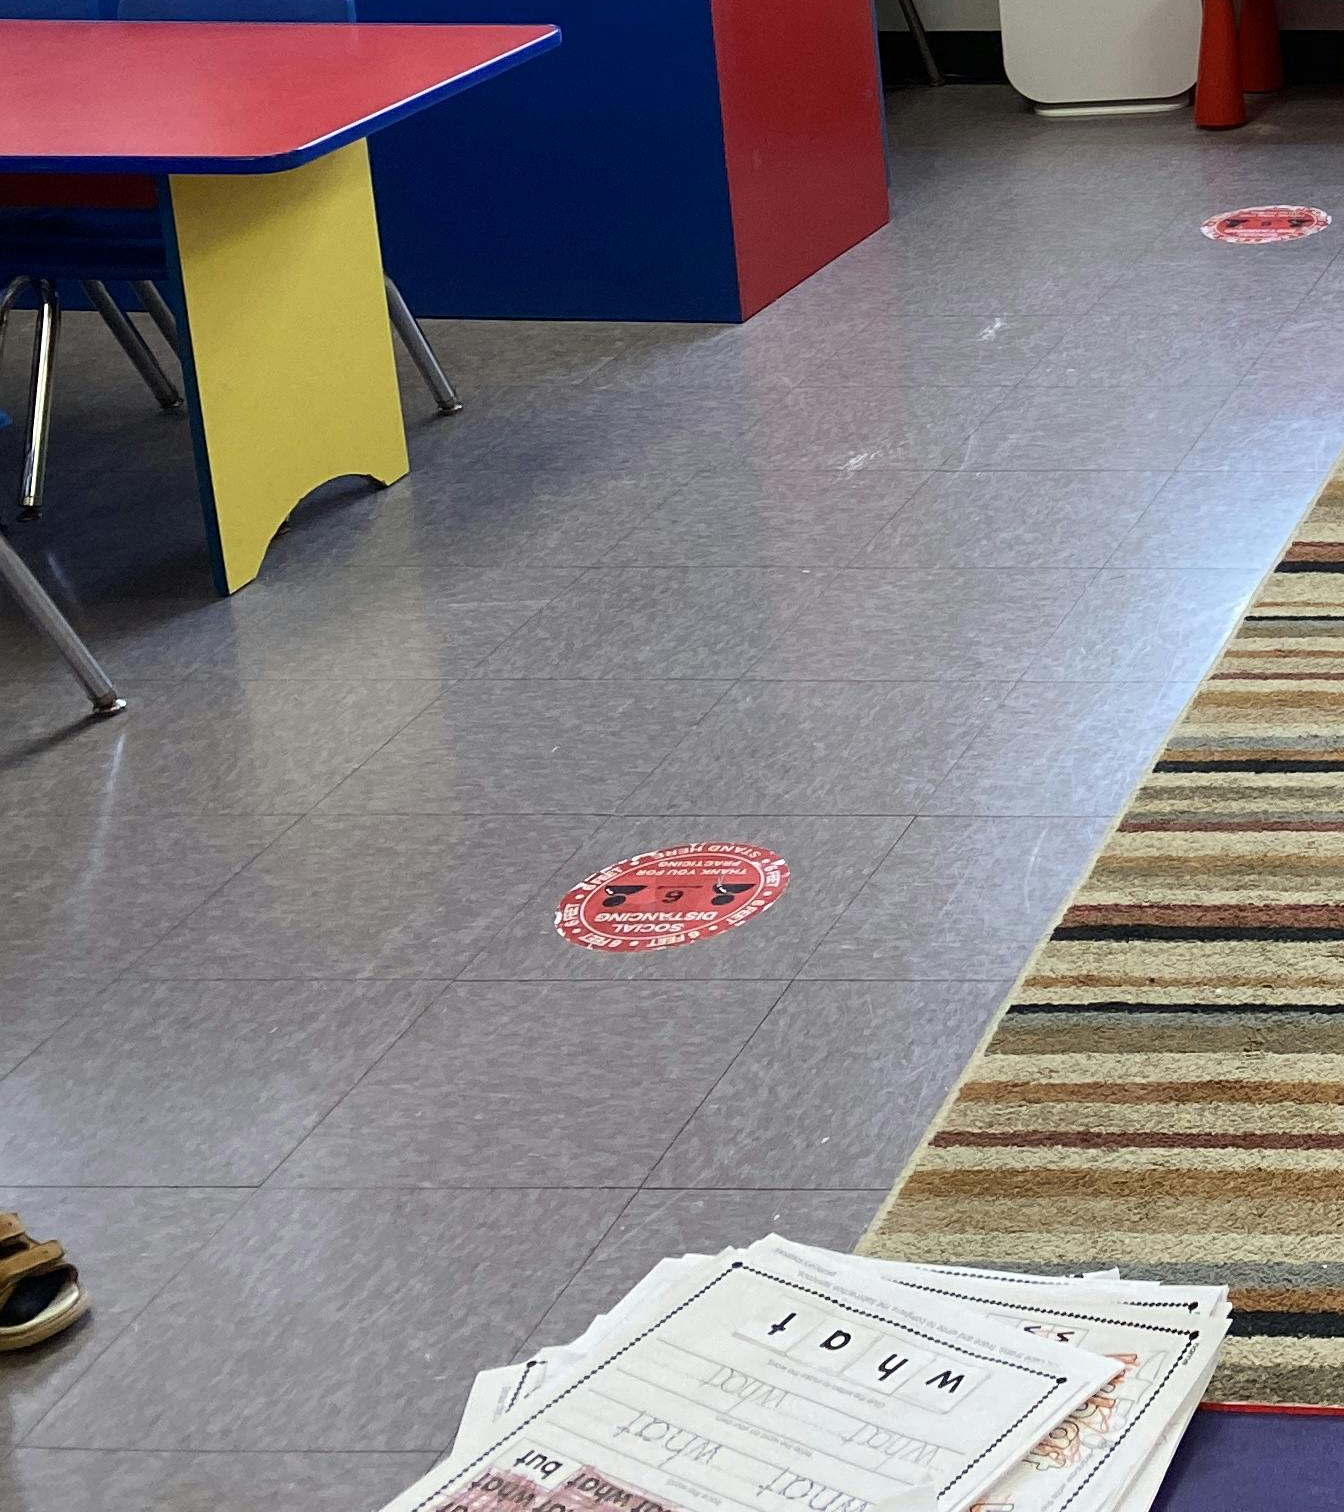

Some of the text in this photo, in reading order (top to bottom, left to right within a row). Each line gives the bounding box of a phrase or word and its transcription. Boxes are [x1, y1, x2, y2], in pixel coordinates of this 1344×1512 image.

[635, 868, 749, 877] THANK YOU FOR
[593, 911, 719, 923] DISTANCING
[612, 922, 685, 933] SOCIAL
[513, 1449, 564, 1479] but
